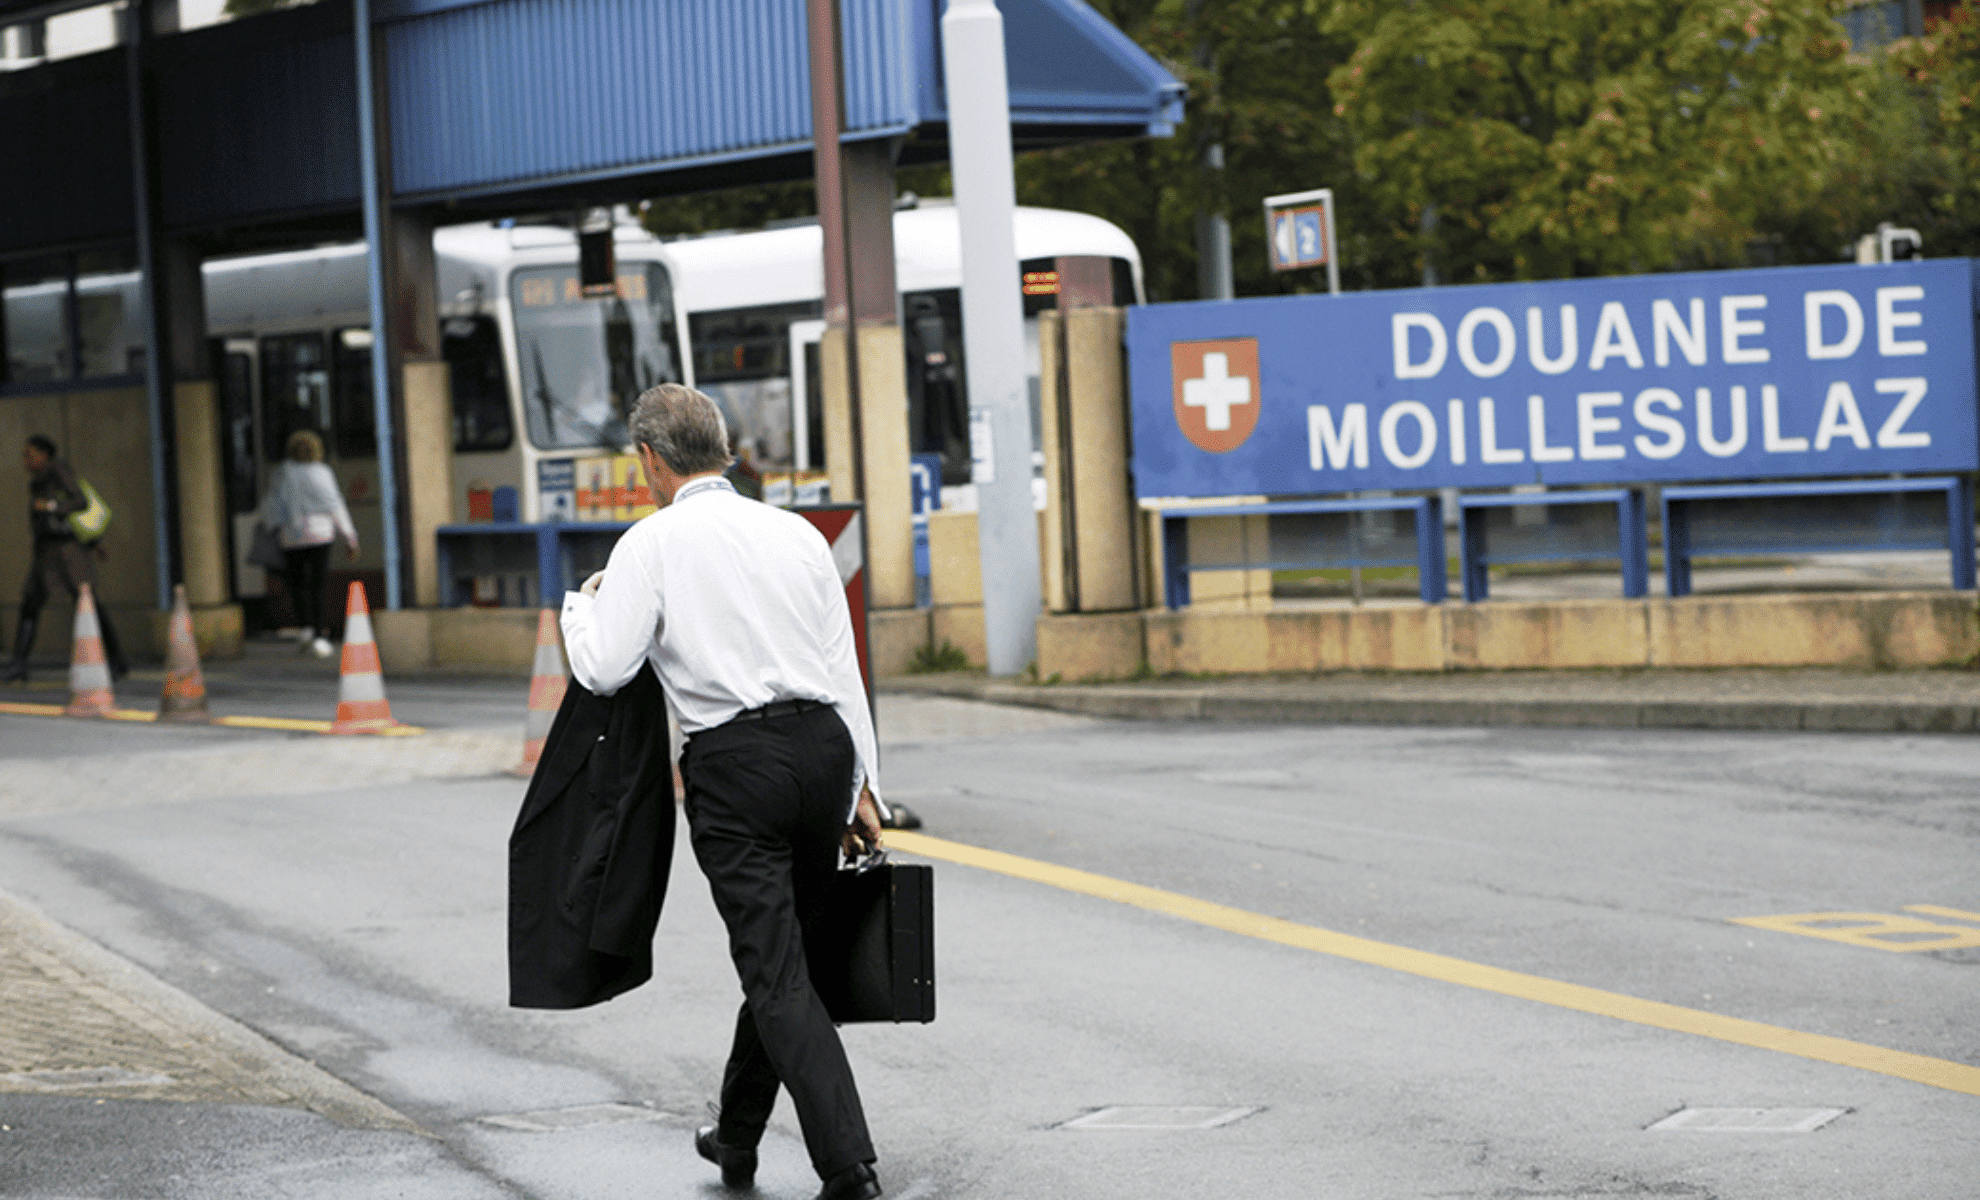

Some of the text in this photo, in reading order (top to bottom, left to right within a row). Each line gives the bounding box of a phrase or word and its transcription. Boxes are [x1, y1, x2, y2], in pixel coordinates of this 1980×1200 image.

[1391, 286, 1928, 380] DOUANE DE
[1307, 377, 1932, 471] MOILLESULAZ
